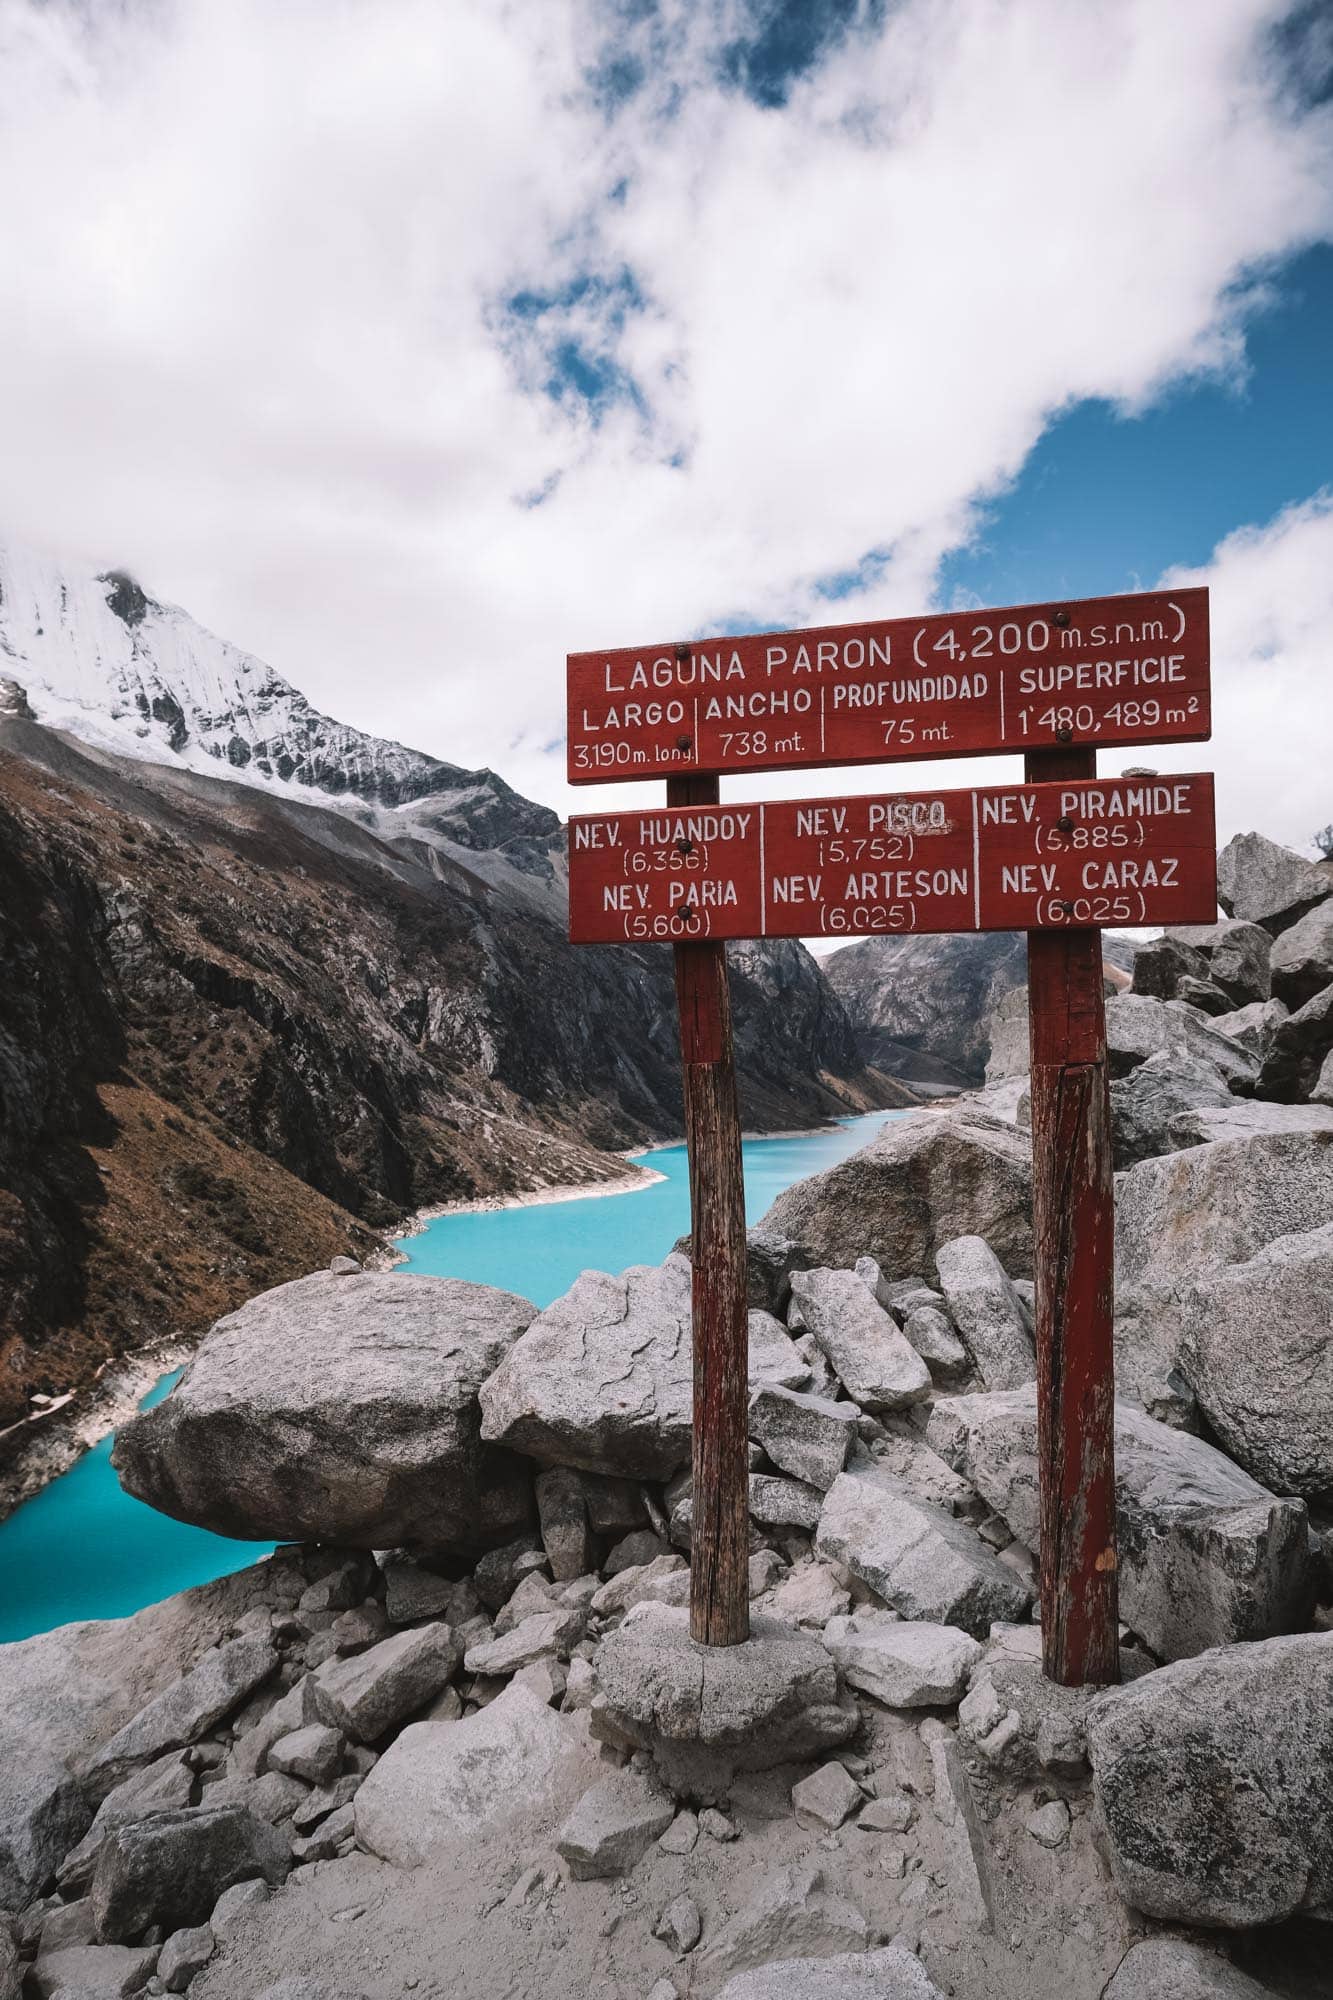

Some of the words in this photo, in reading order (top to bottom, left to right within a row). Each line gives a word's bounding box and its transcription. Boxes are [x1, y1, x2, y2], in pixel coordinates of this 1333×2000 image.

[605, 651, 746, 692] LAGUNA
[766, 636, 891, 677] PARON
[912, 620, 1050, 667] (4,200
[1060, 602, 1186, 649] m.s.n.m.)
[1019, 655, 1186, 693] SUPERFICIE
[705, 688, 811, 720] ANCHO
[833, 672, 988, 709] PROFUNDIDAD
[583, 701, 684, 731] LARGO
[881, 719, 915, 744] 75
[922, 720, 954, 741] mt.
[574, 742, 630, 768] 3,190
[633, 750, 651, 763] m.
[719, 731, 767, 757] 738
[774, 731, 805, 753] mt.
[796, 807, 849, 837] NEV.
[869, 800, 945, 832] PISCO
[982, 794, 1041, 825] NEV.
[1061, 785, 1191, 819] PIRAMIDE
[575, 822, 622, 850] NEV.
[639, 813, 751, 846] HUANDOY
[1035, 820, 1145, 855] (5,885)
[623, 845, 708, 876] (6,356)
[819, 834, 914, 866] (5,752)
[773, 875, 825, 903] NEV.
[845, 868, 967, 900] ARTESON
[1002, 864, 1061, 893] NEV.
[1082, 859, 1179, 890] CARAZ
[604, 884, 652, 911] NEV.
[669, 880, 738, 907] PARIA
[1036, 892, 1146, 924] (6,025)
[624, 910, 710, 938] (5,600)
[820, 901, 916, 931] (6,025)
